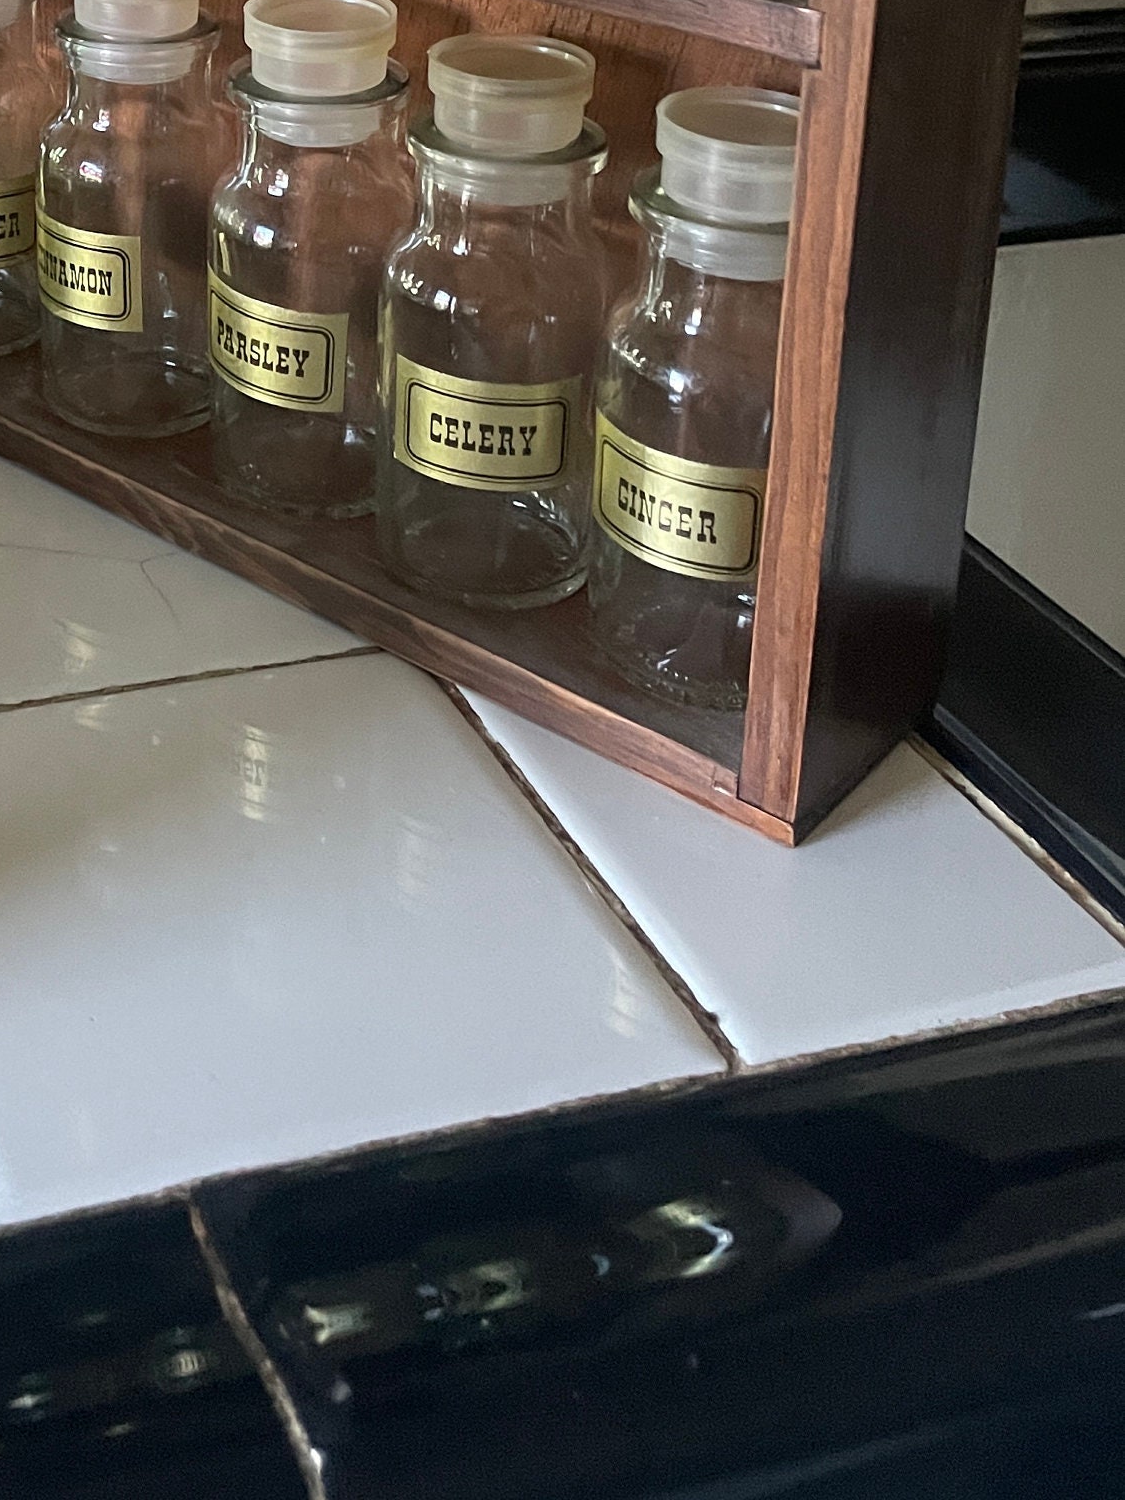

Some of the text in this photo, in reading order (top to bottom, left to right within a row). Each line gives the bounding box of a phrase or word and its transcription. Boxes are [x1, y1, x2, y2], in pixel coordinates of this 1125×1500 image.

[217, 315, 311, 378] PARSLEY
[430, 412, 538, 456] CELERY
[618, 476, 717, 544] GINGER
